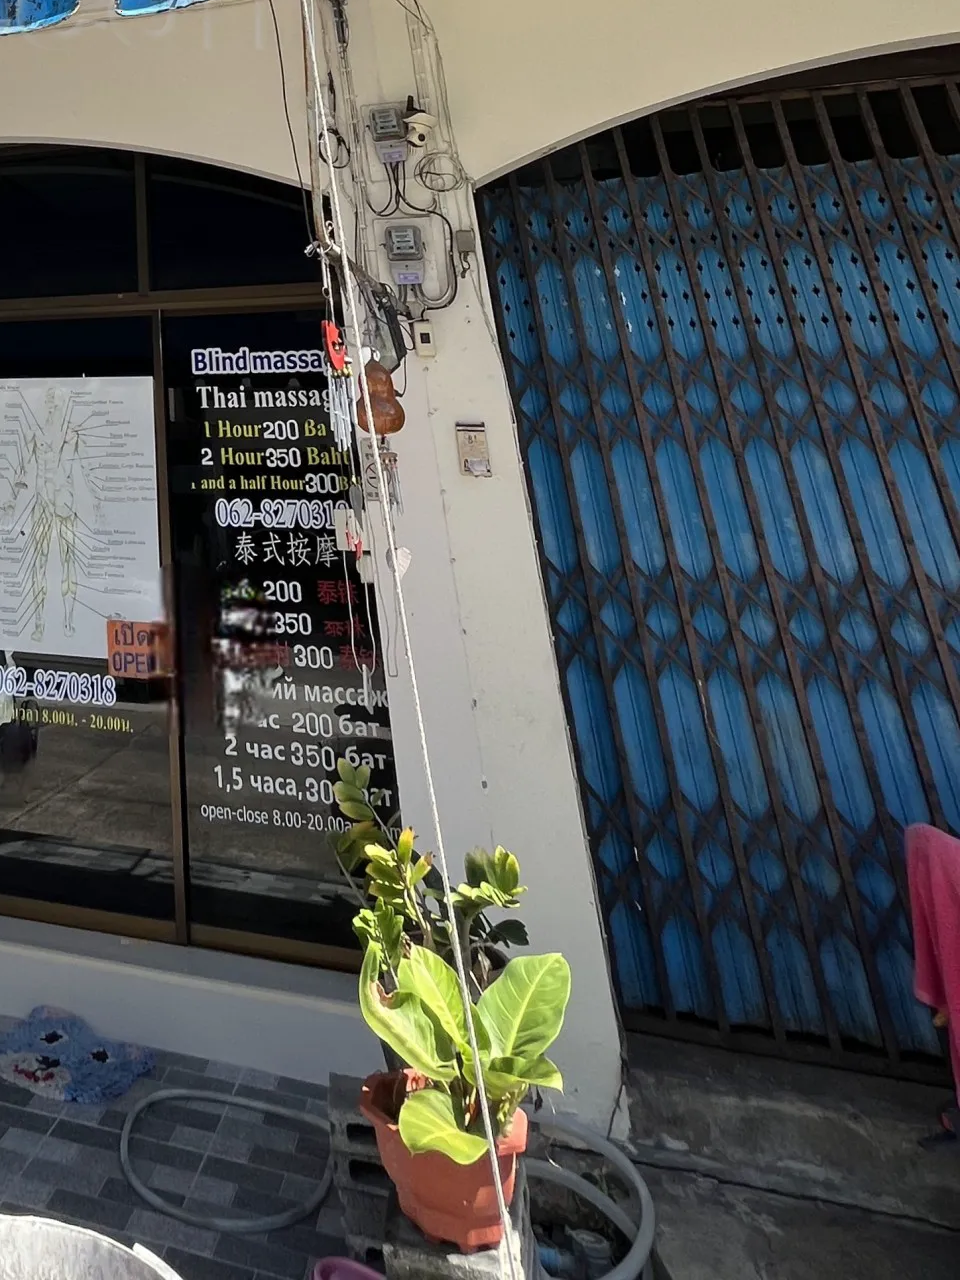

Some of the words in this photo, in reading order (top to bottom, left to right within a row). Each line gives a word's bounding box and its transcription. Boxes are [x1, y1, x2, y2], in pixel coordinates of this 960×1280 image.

[196, 384, 247, 409] Thai
[253, 389, 330, 413] massag
[304, 419, 327, 437] Ba
[201, 447, 214, 466] 2
[307, 446, 350, 466] Baht
[201, 475, 225, 490] and
[229, 479, 237, 490] a
[240, 475, 268, 490] half
[215, 498, 349, 529] 062-827031
[262, 579, 303, 603] 200
[273, 612, 312, 635] 350
[294, 644, 334, 669] 300
[291, 712, 334, 738] 200
[339, 714, 381, 738] бат
[225, 734, 238, 756] 2
[245, 742, 286, 761] час
[290, 741, 336, 772] 350
[345, 745, 387, 770] бат
[214, 764, 243, 793] 1,5
[304, 777, 335, 805] 30
[200, 804, 269, 826] open-close
